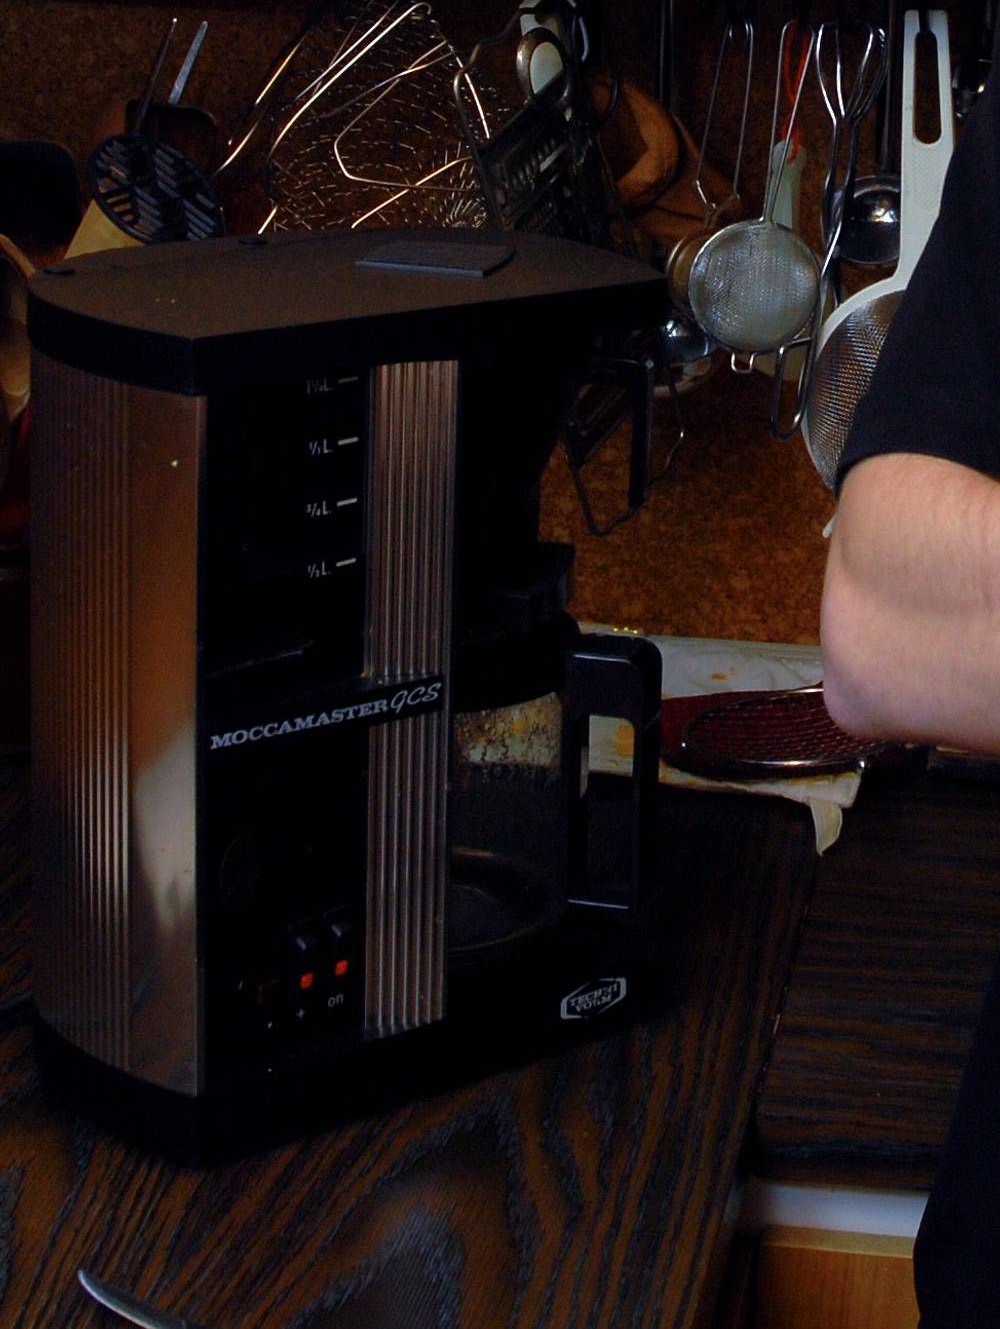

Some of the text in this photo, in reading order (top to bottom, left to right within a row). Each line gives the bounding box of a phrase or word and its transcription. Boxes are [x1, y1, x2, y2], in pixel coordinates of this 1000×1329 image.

[210, 682, 442, 749] MOCCAMASTER GCS
[327, 992, 343, 1008] on
